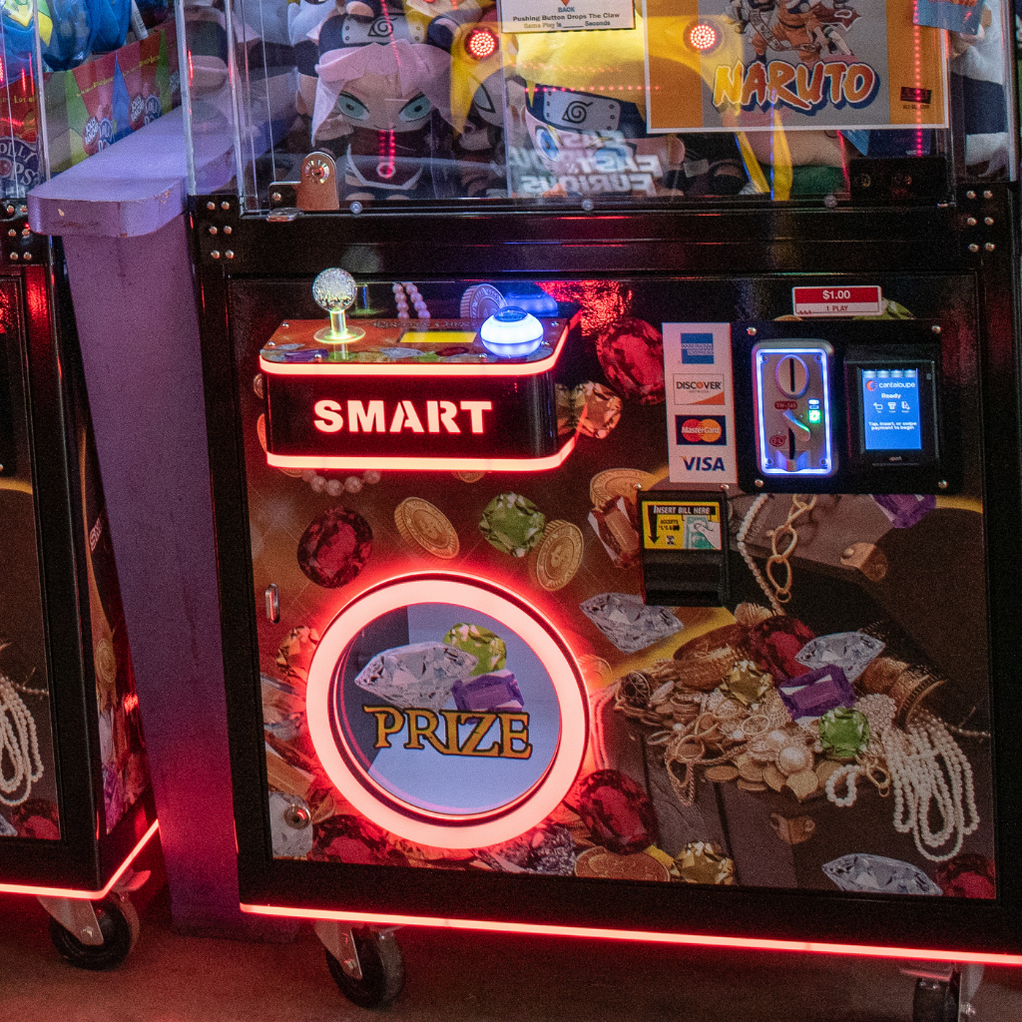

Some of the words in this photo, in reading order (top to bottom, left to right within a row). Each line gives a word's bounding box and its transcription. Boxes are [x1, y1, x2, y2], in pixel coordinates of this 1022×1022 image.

[713, 60, 876, 110] NARUTO
[822, 289, 851, 300] $1.00
[676, 381, 721, 390] DISCOVER
[313, 399, 492, 434] SMART
[682, 425, 721, 434] MasterCard
[681, 456, 725, 471] VISA
[653, 505, 677, 514] INSERT
[678, 506, 692, 514] BILL
[362, 704, 533, 760] PRIZE
